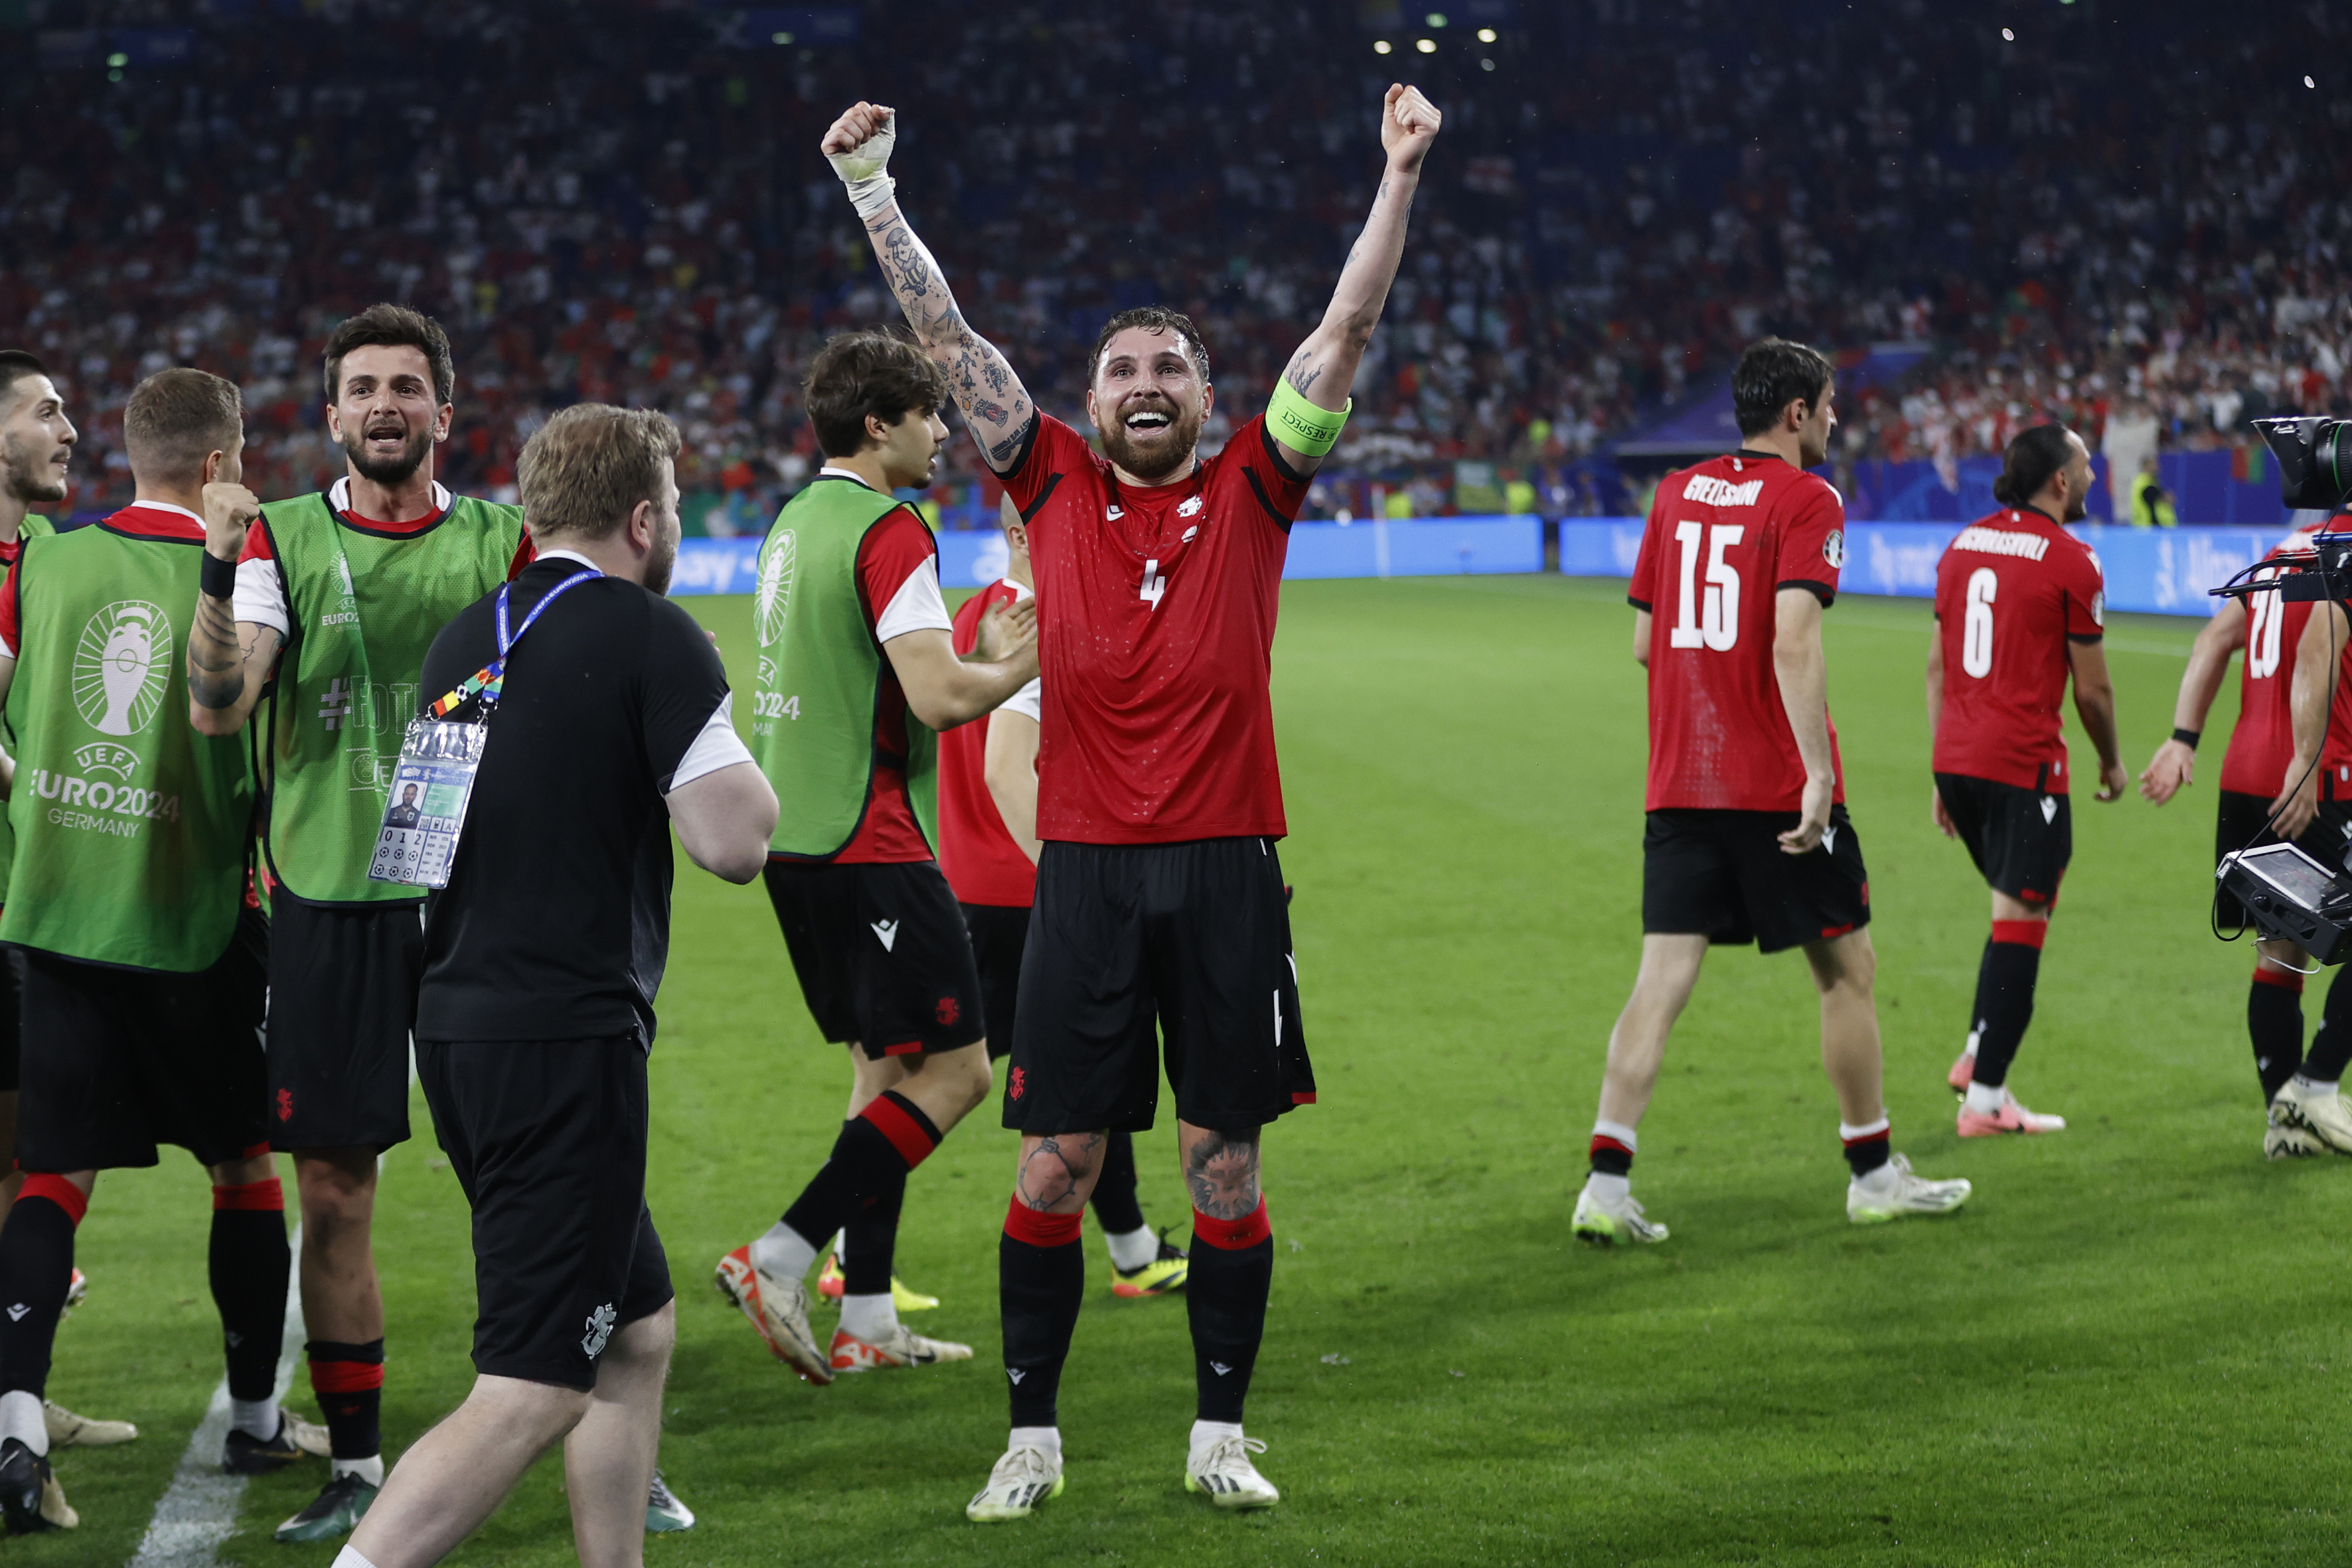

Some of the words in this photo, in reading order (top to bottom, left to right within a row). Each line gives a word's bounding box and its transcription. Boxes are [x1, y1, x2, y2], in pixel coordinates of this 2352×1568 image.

[1281, 411, 1327, 439] RESPECT
[1139, 559, 1166, 612] 4
[1670, 520, 1745, 652] 15
[1962, 567, 1998, 679] 6
[77, 747, 135, 777] UEFA
[48, 808, 139, 838] GERMANY
[385, 830, 393, 842] 0
[399, 832, 406, 843] 1
[414, 834, 422, 845] 2
